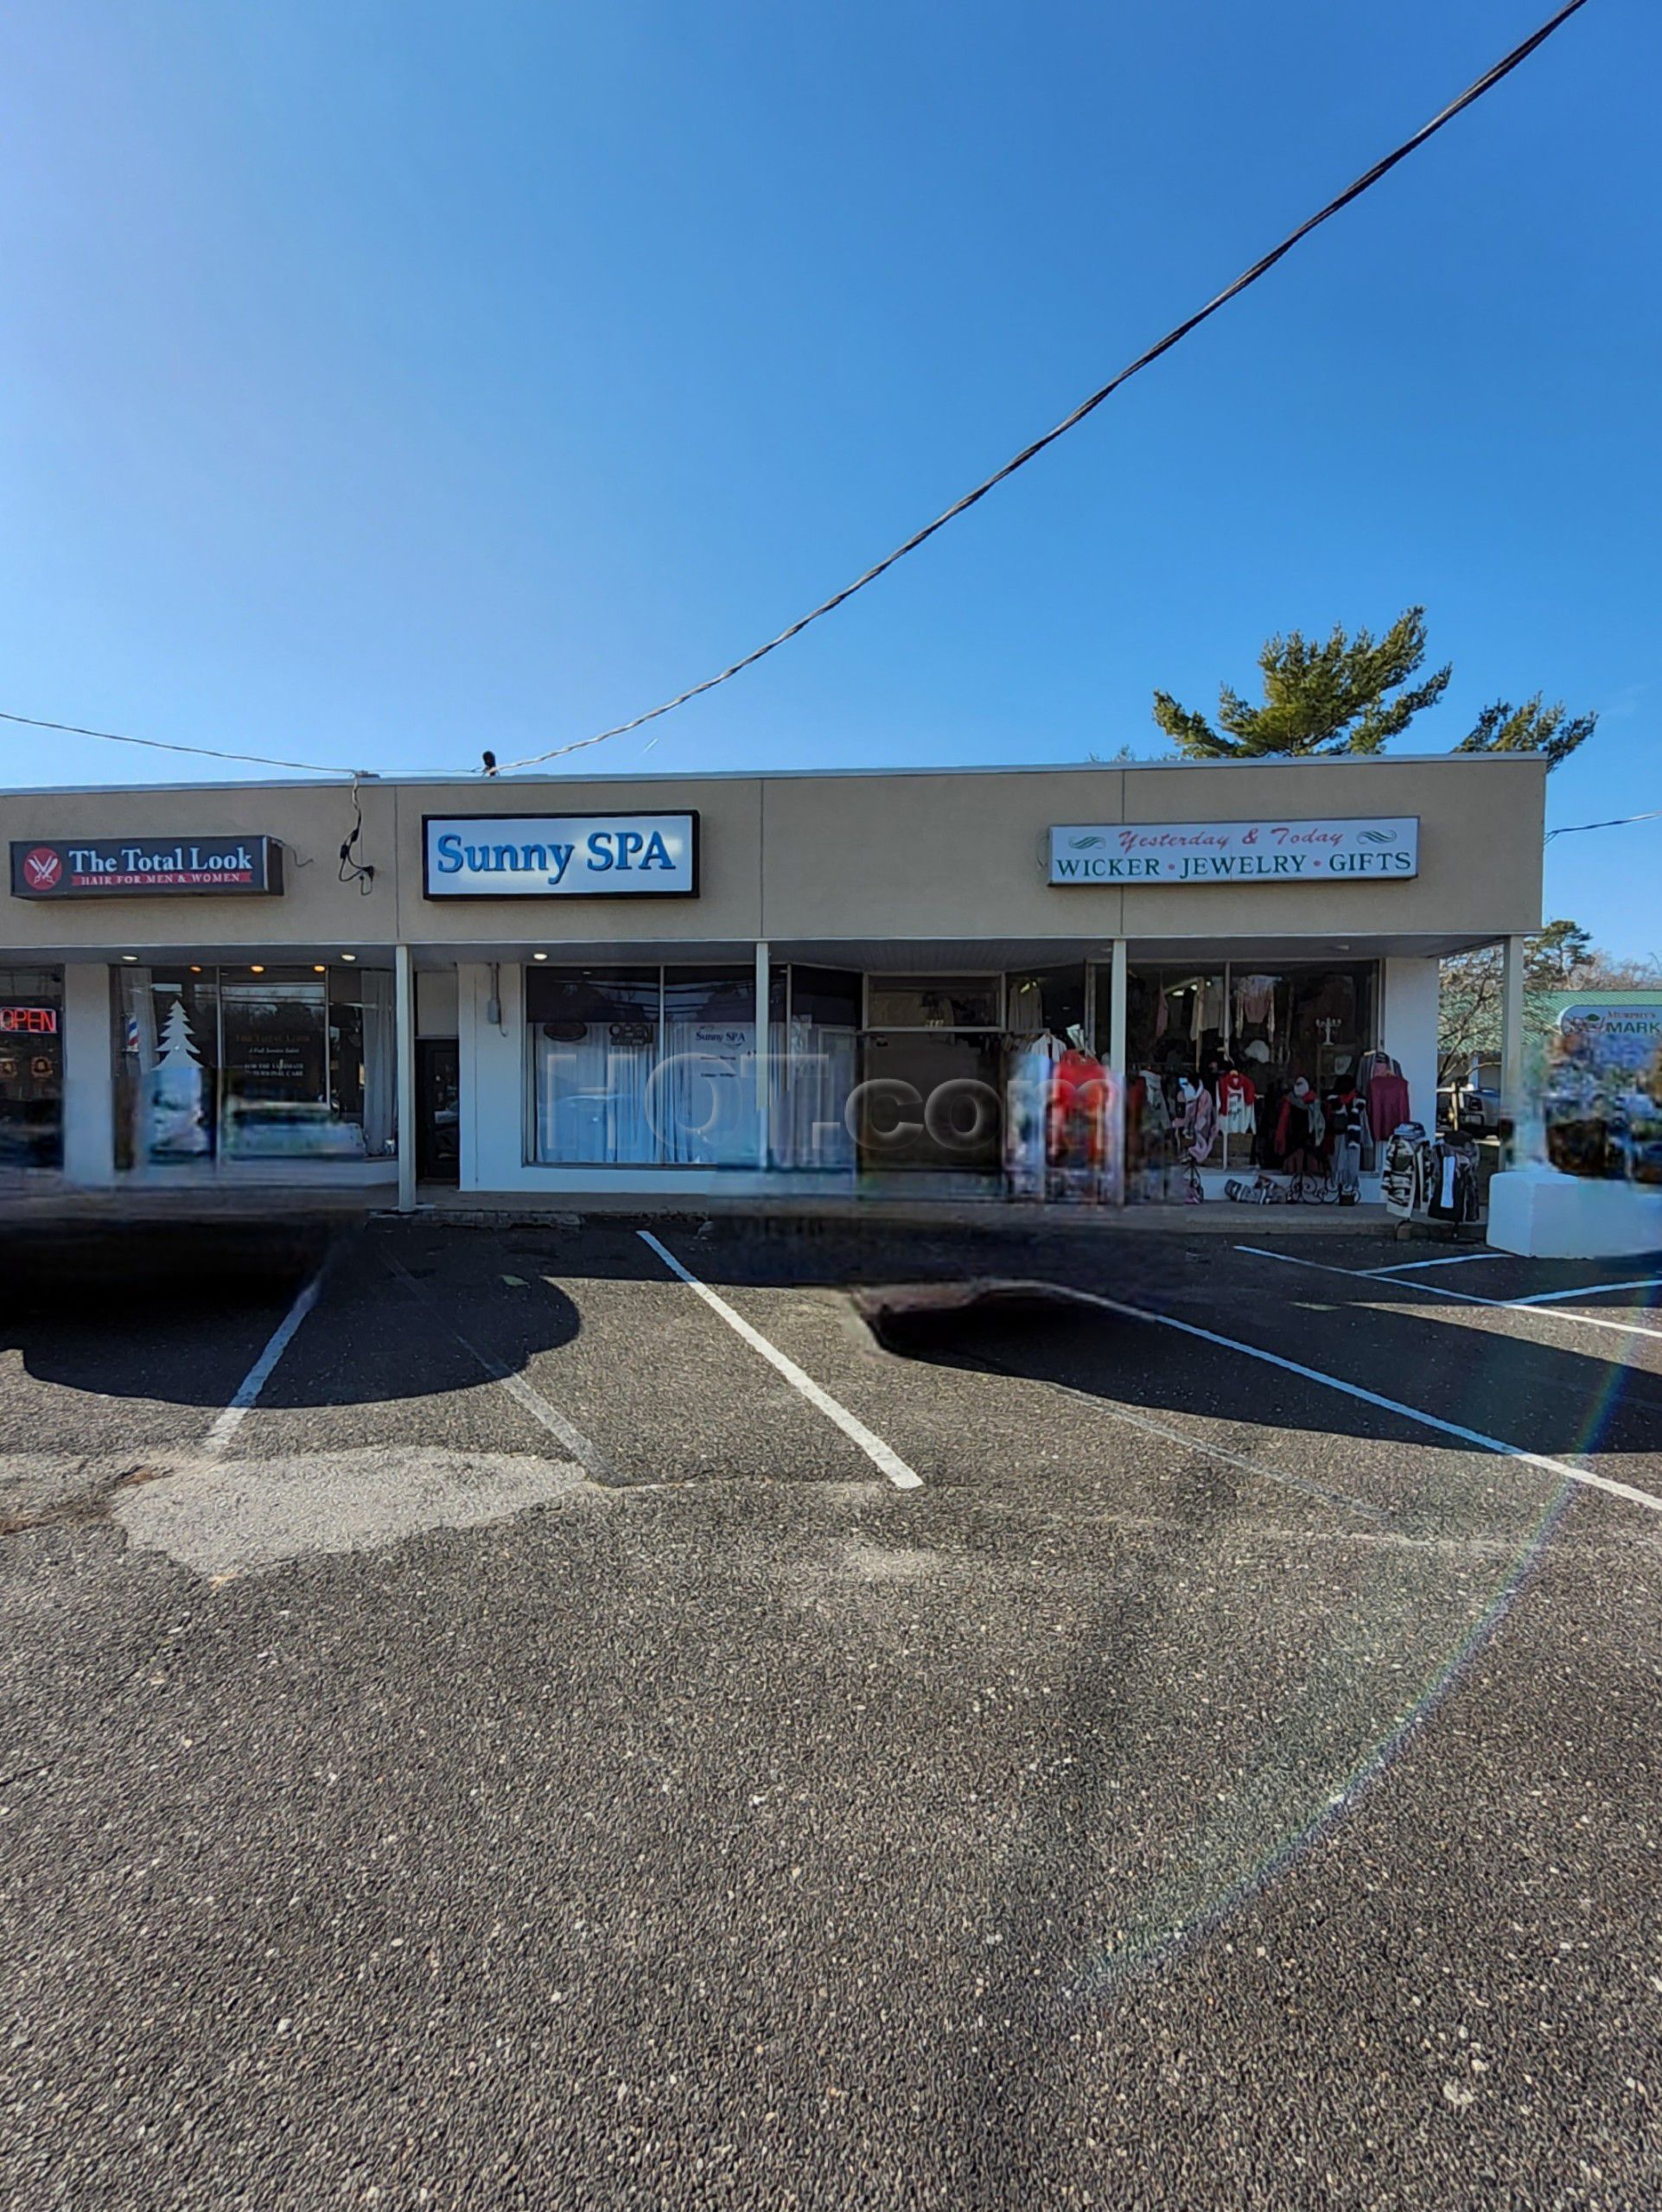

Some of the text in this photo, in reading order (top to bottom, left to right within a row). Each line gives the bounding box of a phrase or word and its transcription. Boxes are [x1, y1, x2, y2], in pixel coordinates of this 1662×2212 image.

[1118, 827, 1345, 854] Yesterday & Today
[68, 846, 253, 873] The Total Look
[437, 830, 676, 885] Sunny SPA
[1056, 851, 1412, 879] WICKER JEWELRY GIFTS
[81, 873, 240, 886] HAIR FOR MEN & WOMEN
[1, 1008, 56, 1032] OPEN
[726, 1032, 746, 1042] SPA
